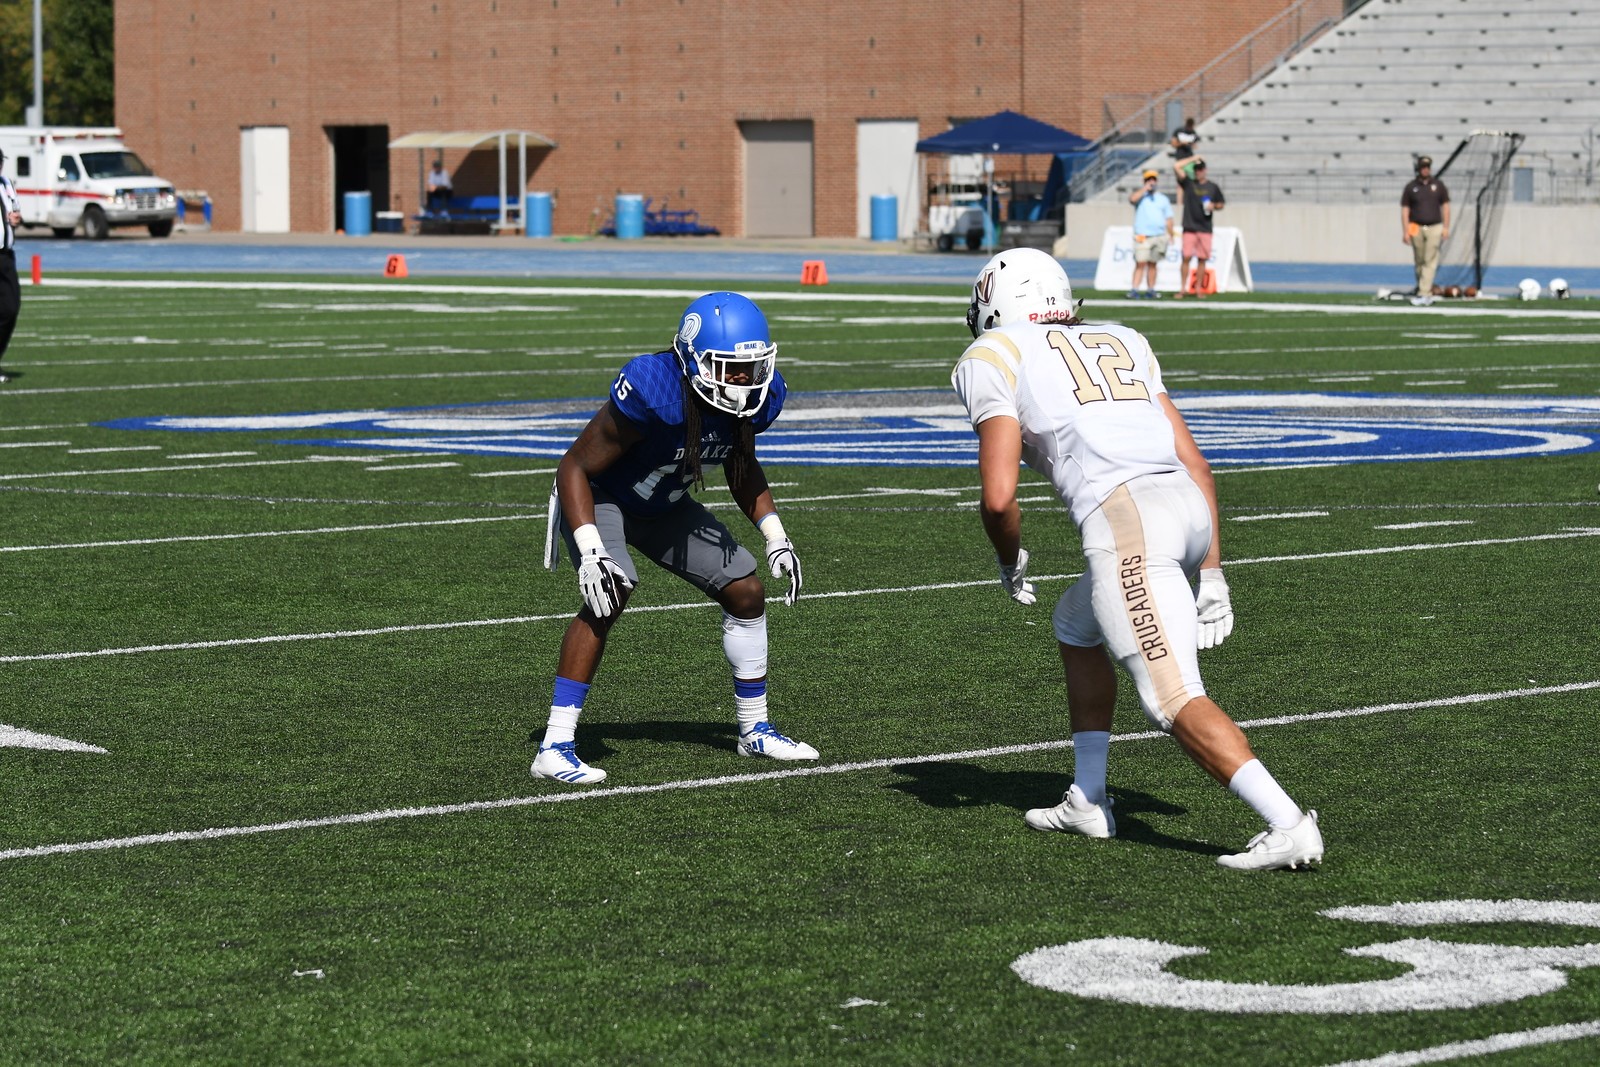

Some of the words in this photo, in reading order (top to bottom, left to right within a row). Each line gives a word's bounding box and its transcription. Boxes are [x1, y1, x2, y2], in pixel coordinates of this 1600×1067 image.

[805, 264, 820, 283] 10
[1046, 296, 1056, 306] 12
[1046, 330, 1152, 406] 12
[614, 372, 633, 401] 15
[674, 445, 733, 461] DAKE
[1121, 554, 1168, 662] CRUSADERS
